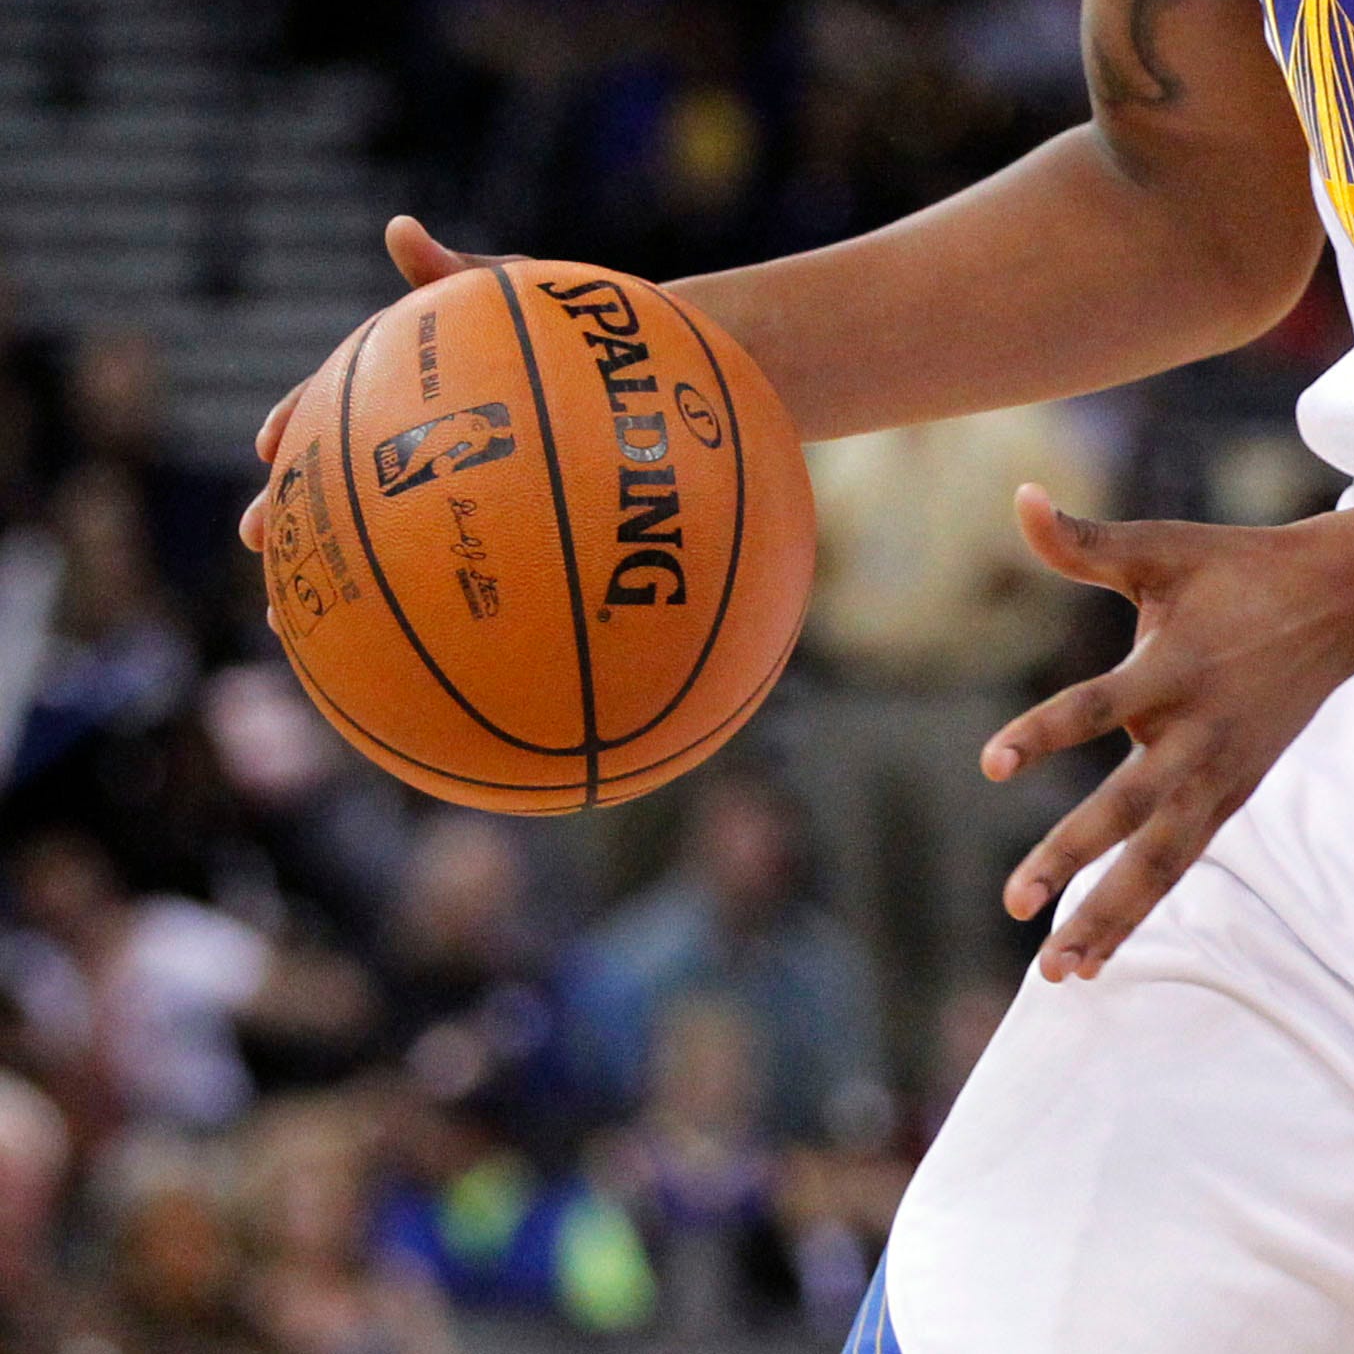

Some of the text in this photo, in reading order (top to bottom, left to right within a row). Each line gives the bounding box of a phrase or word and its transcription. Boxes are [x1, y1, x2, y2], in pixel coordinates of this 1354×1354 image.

[421, 373, 440, 402] BALL
[537, 277, 687, 607] SPALDING
[379, 443, 401, 482] NBA
